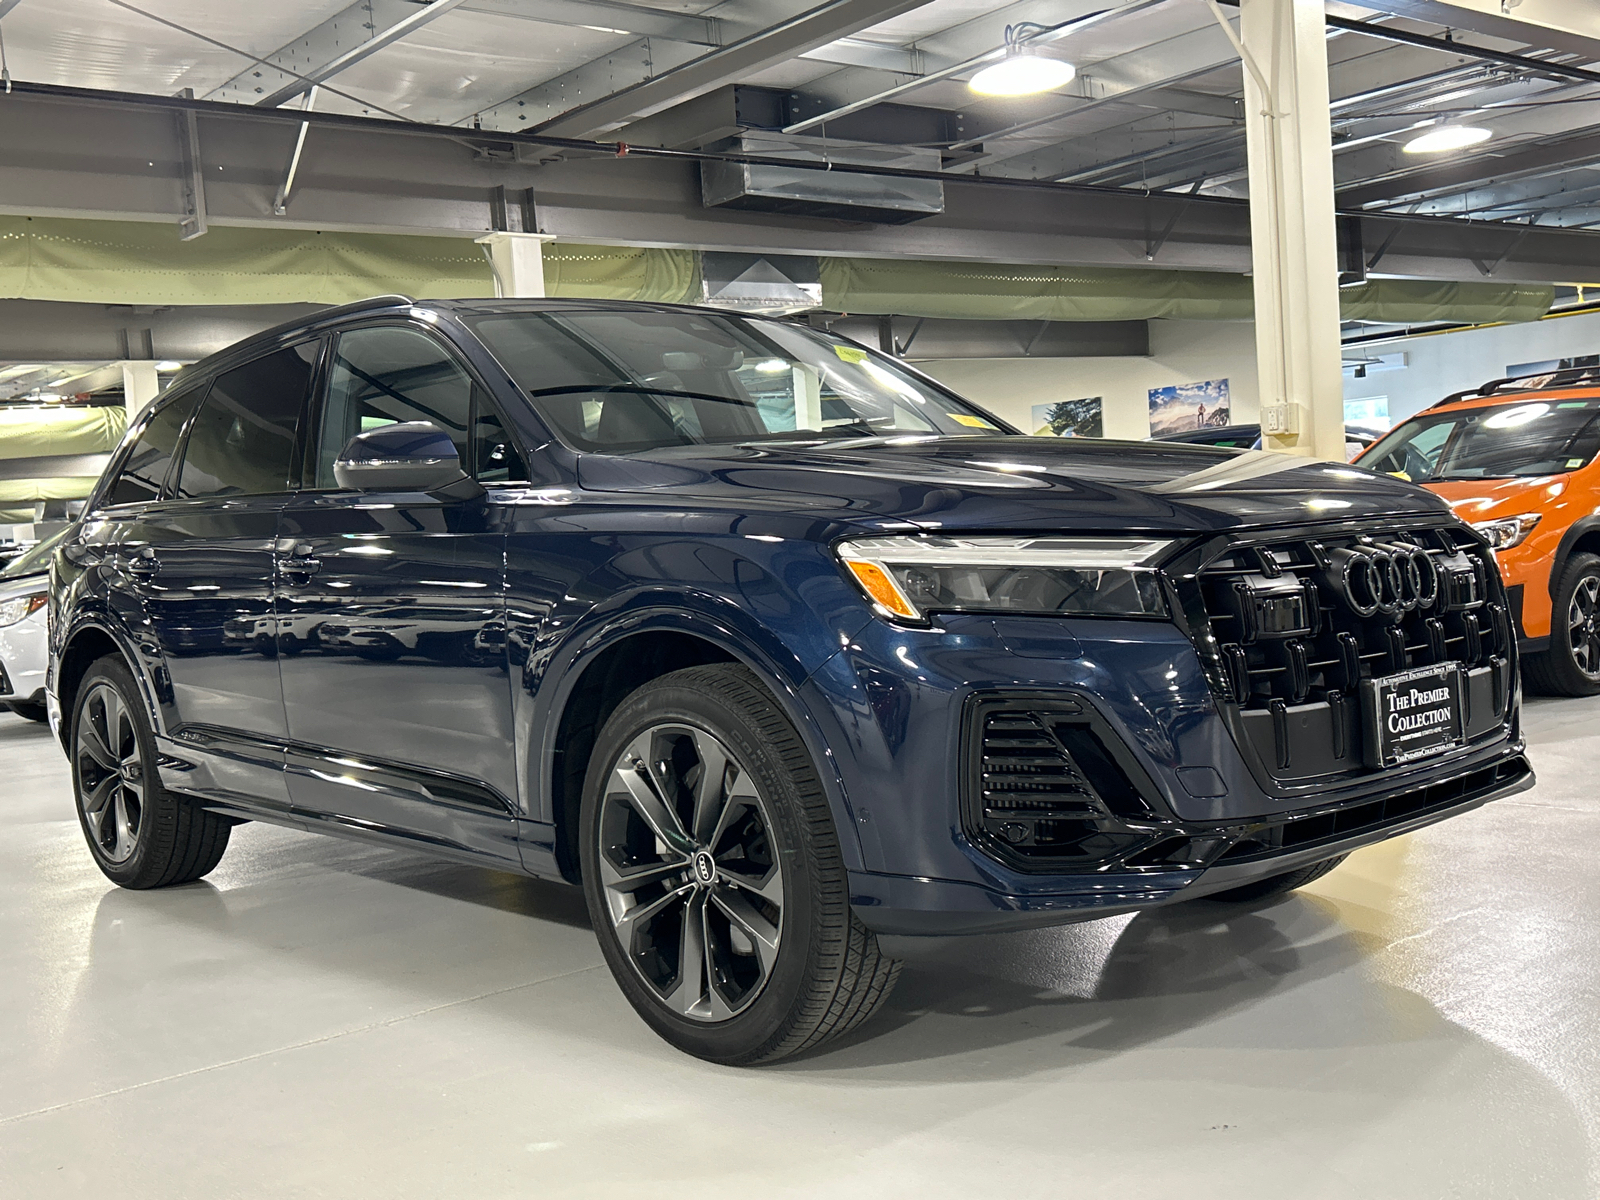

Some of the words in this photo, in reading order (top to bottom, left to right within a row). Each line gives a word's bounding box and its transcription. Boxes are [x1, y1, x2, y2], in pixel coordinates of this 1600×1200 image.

[1387, 693, 1409, 712] THE
[1409, 687, 1450, 707] PREMIER
[1388, 707, 1451, 733] COLLECTION
